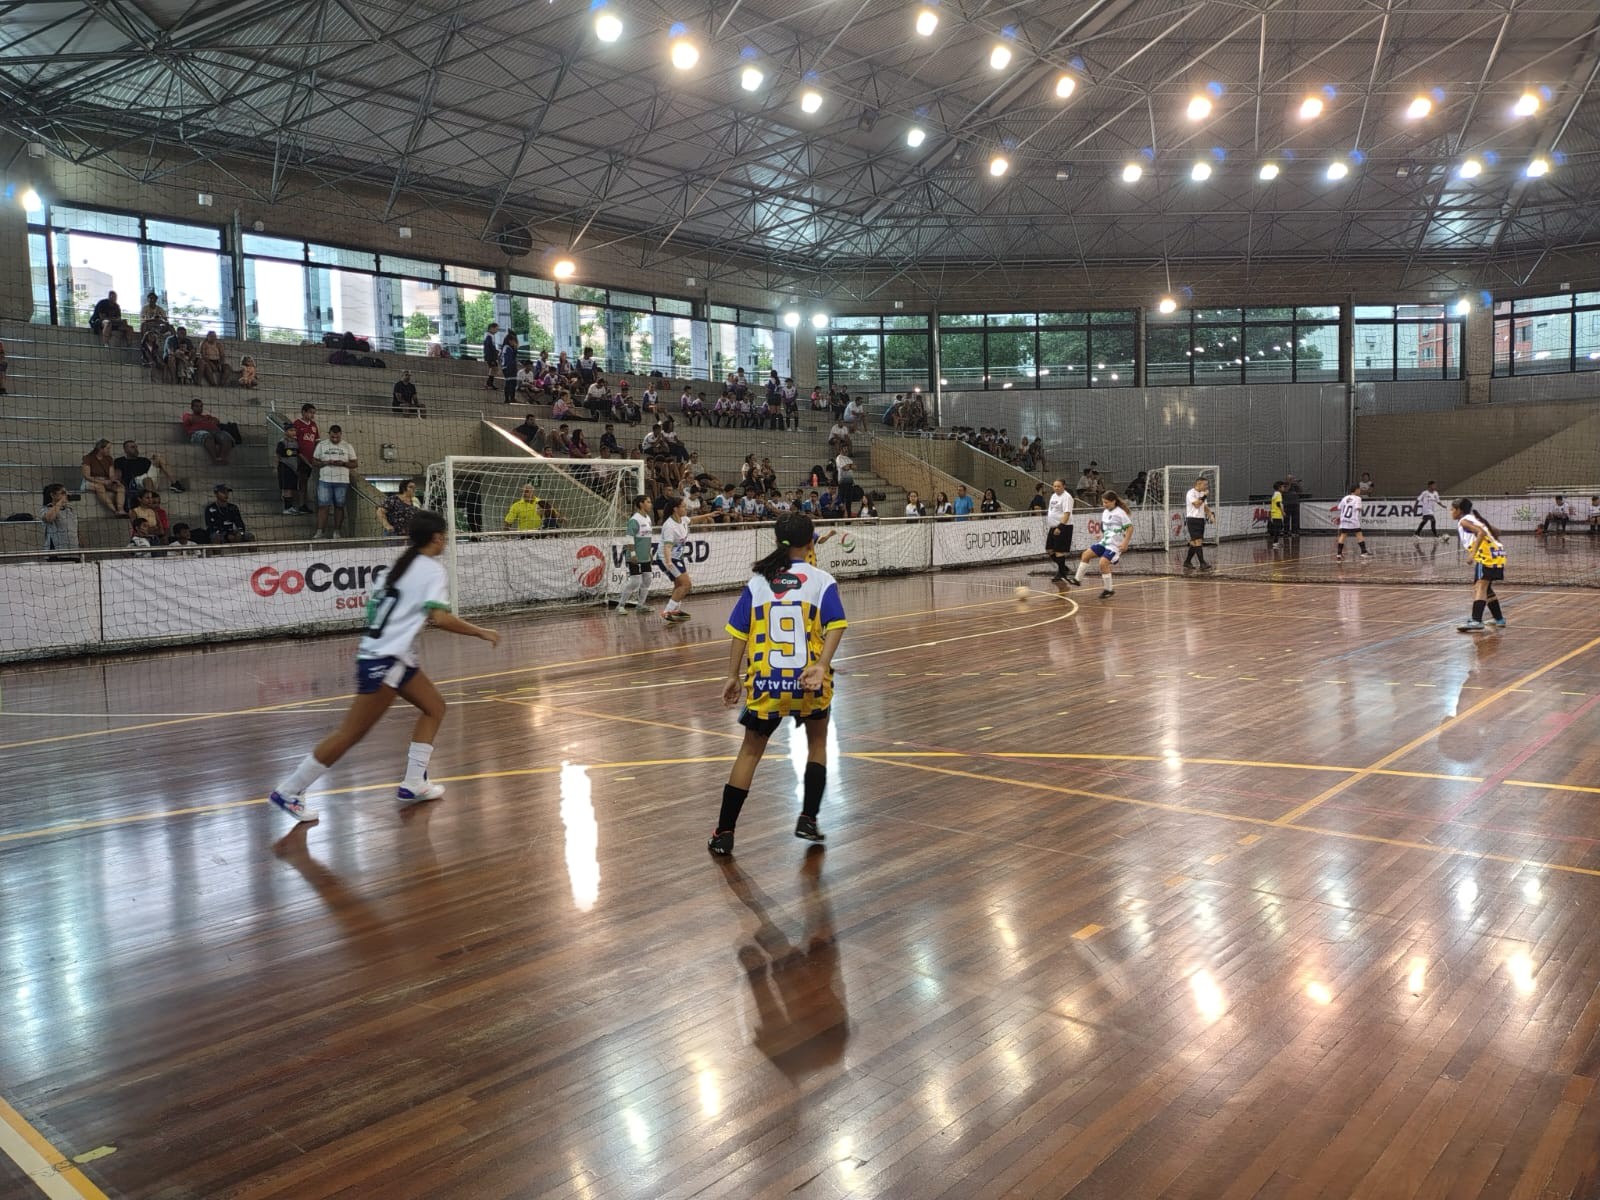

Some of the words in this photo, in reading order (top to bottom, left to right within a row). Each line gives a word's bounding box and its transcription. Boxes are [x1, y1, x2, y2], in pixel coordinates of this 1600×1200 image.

[841, 558, 868, 567] WORLD
[769, 604, 809, 669] 9
[768, 680, 780, 690] tv
